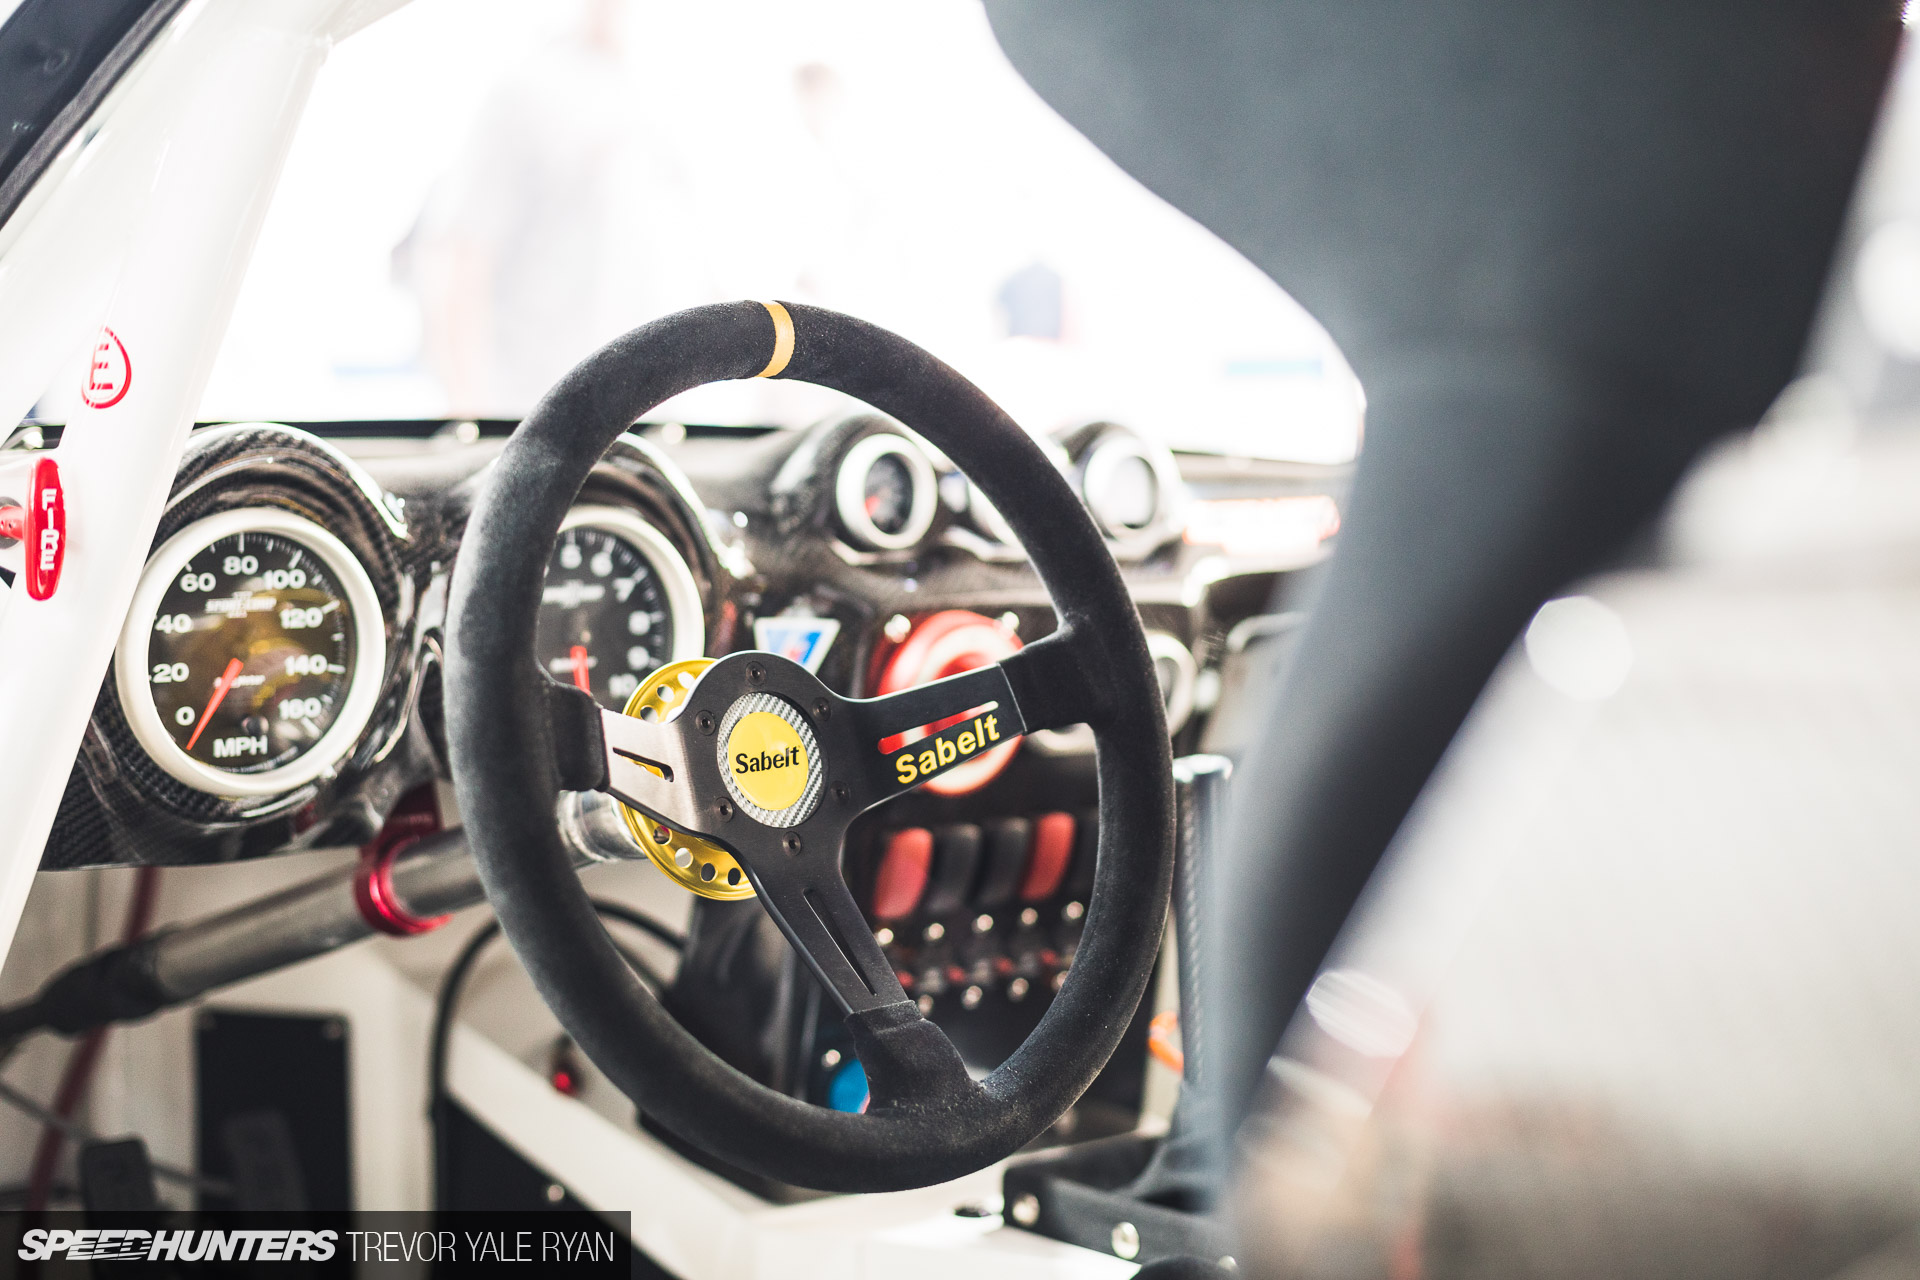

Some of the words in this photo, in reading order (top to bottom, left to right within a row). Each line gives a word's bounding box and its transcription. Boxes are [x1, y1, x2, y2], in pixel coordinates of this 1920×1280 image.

[40, 488, 60, 571] FIRE
[223, 555, 259, 575] 80
[180, 572, 216, 592] 60
[263, 569, 307, 590] 100
[155, 613, 192, 634] 40
[280, 607, 323, 629] 120
[152, 662, 189, 683] 20
[285, 654, 328, 676] 140
[175, 705, 196, 726] 0
[213, 735, 268, 758] MPH
[896, 714, 1000, 784] Sabelt
[735, 746, 800, 774] Sabelt
